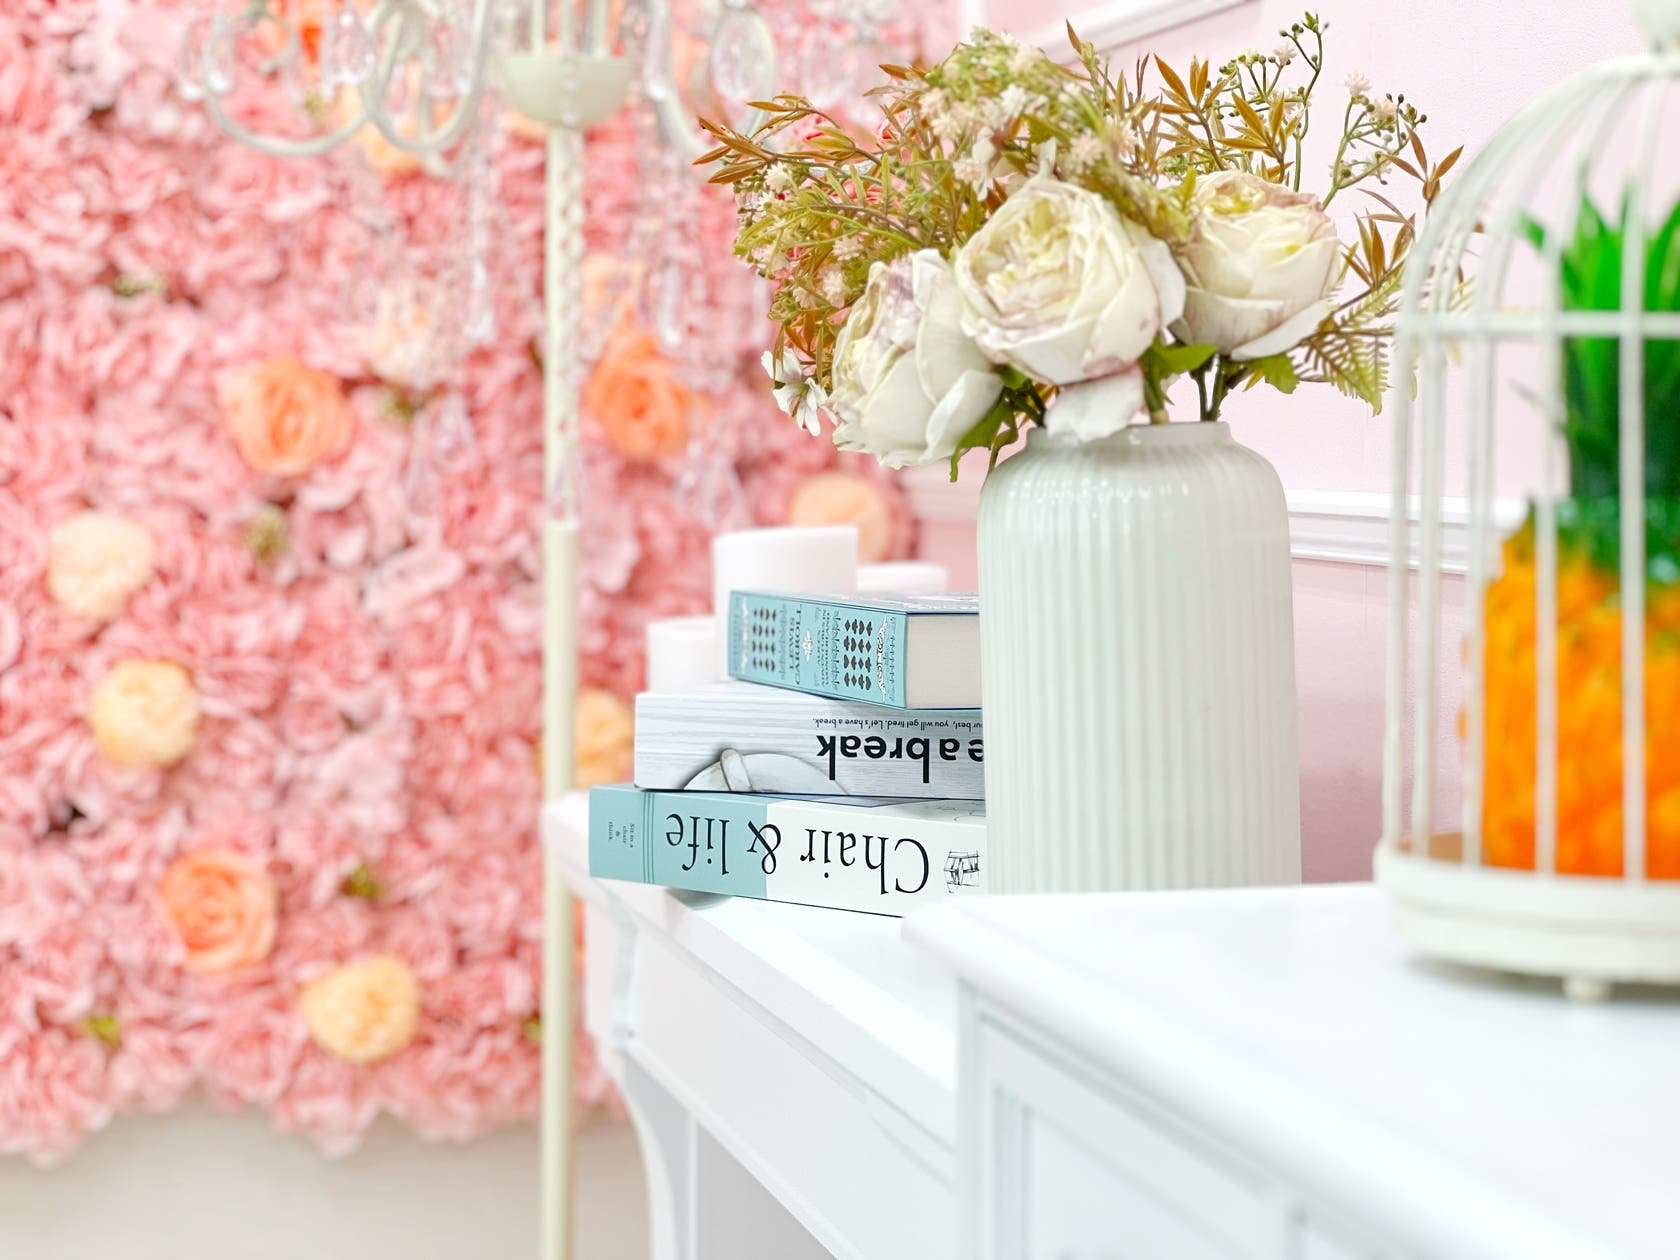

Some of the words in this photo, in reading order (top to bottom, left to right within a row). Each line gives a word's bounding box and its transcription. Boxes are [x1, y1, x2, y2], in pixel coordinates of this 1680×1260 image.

[812, 718, 837, 729] break.
[845, 719, 863, 729] have
[865, 719, 883, 729] Let's
[885, 720, 904, 730] tired.
[907, 719, 919, 728] get
[920, 721, 933, 731] will
[934, 720, 949, 728] you
[953, 722, 972, 732] best,
[939, 738, 960, 761] a
[816, 735, 930, 783] break
[665, 813, 730, 876] life
[746, 820, 782, 875] &
[799, 828, 930, 896] Chair
